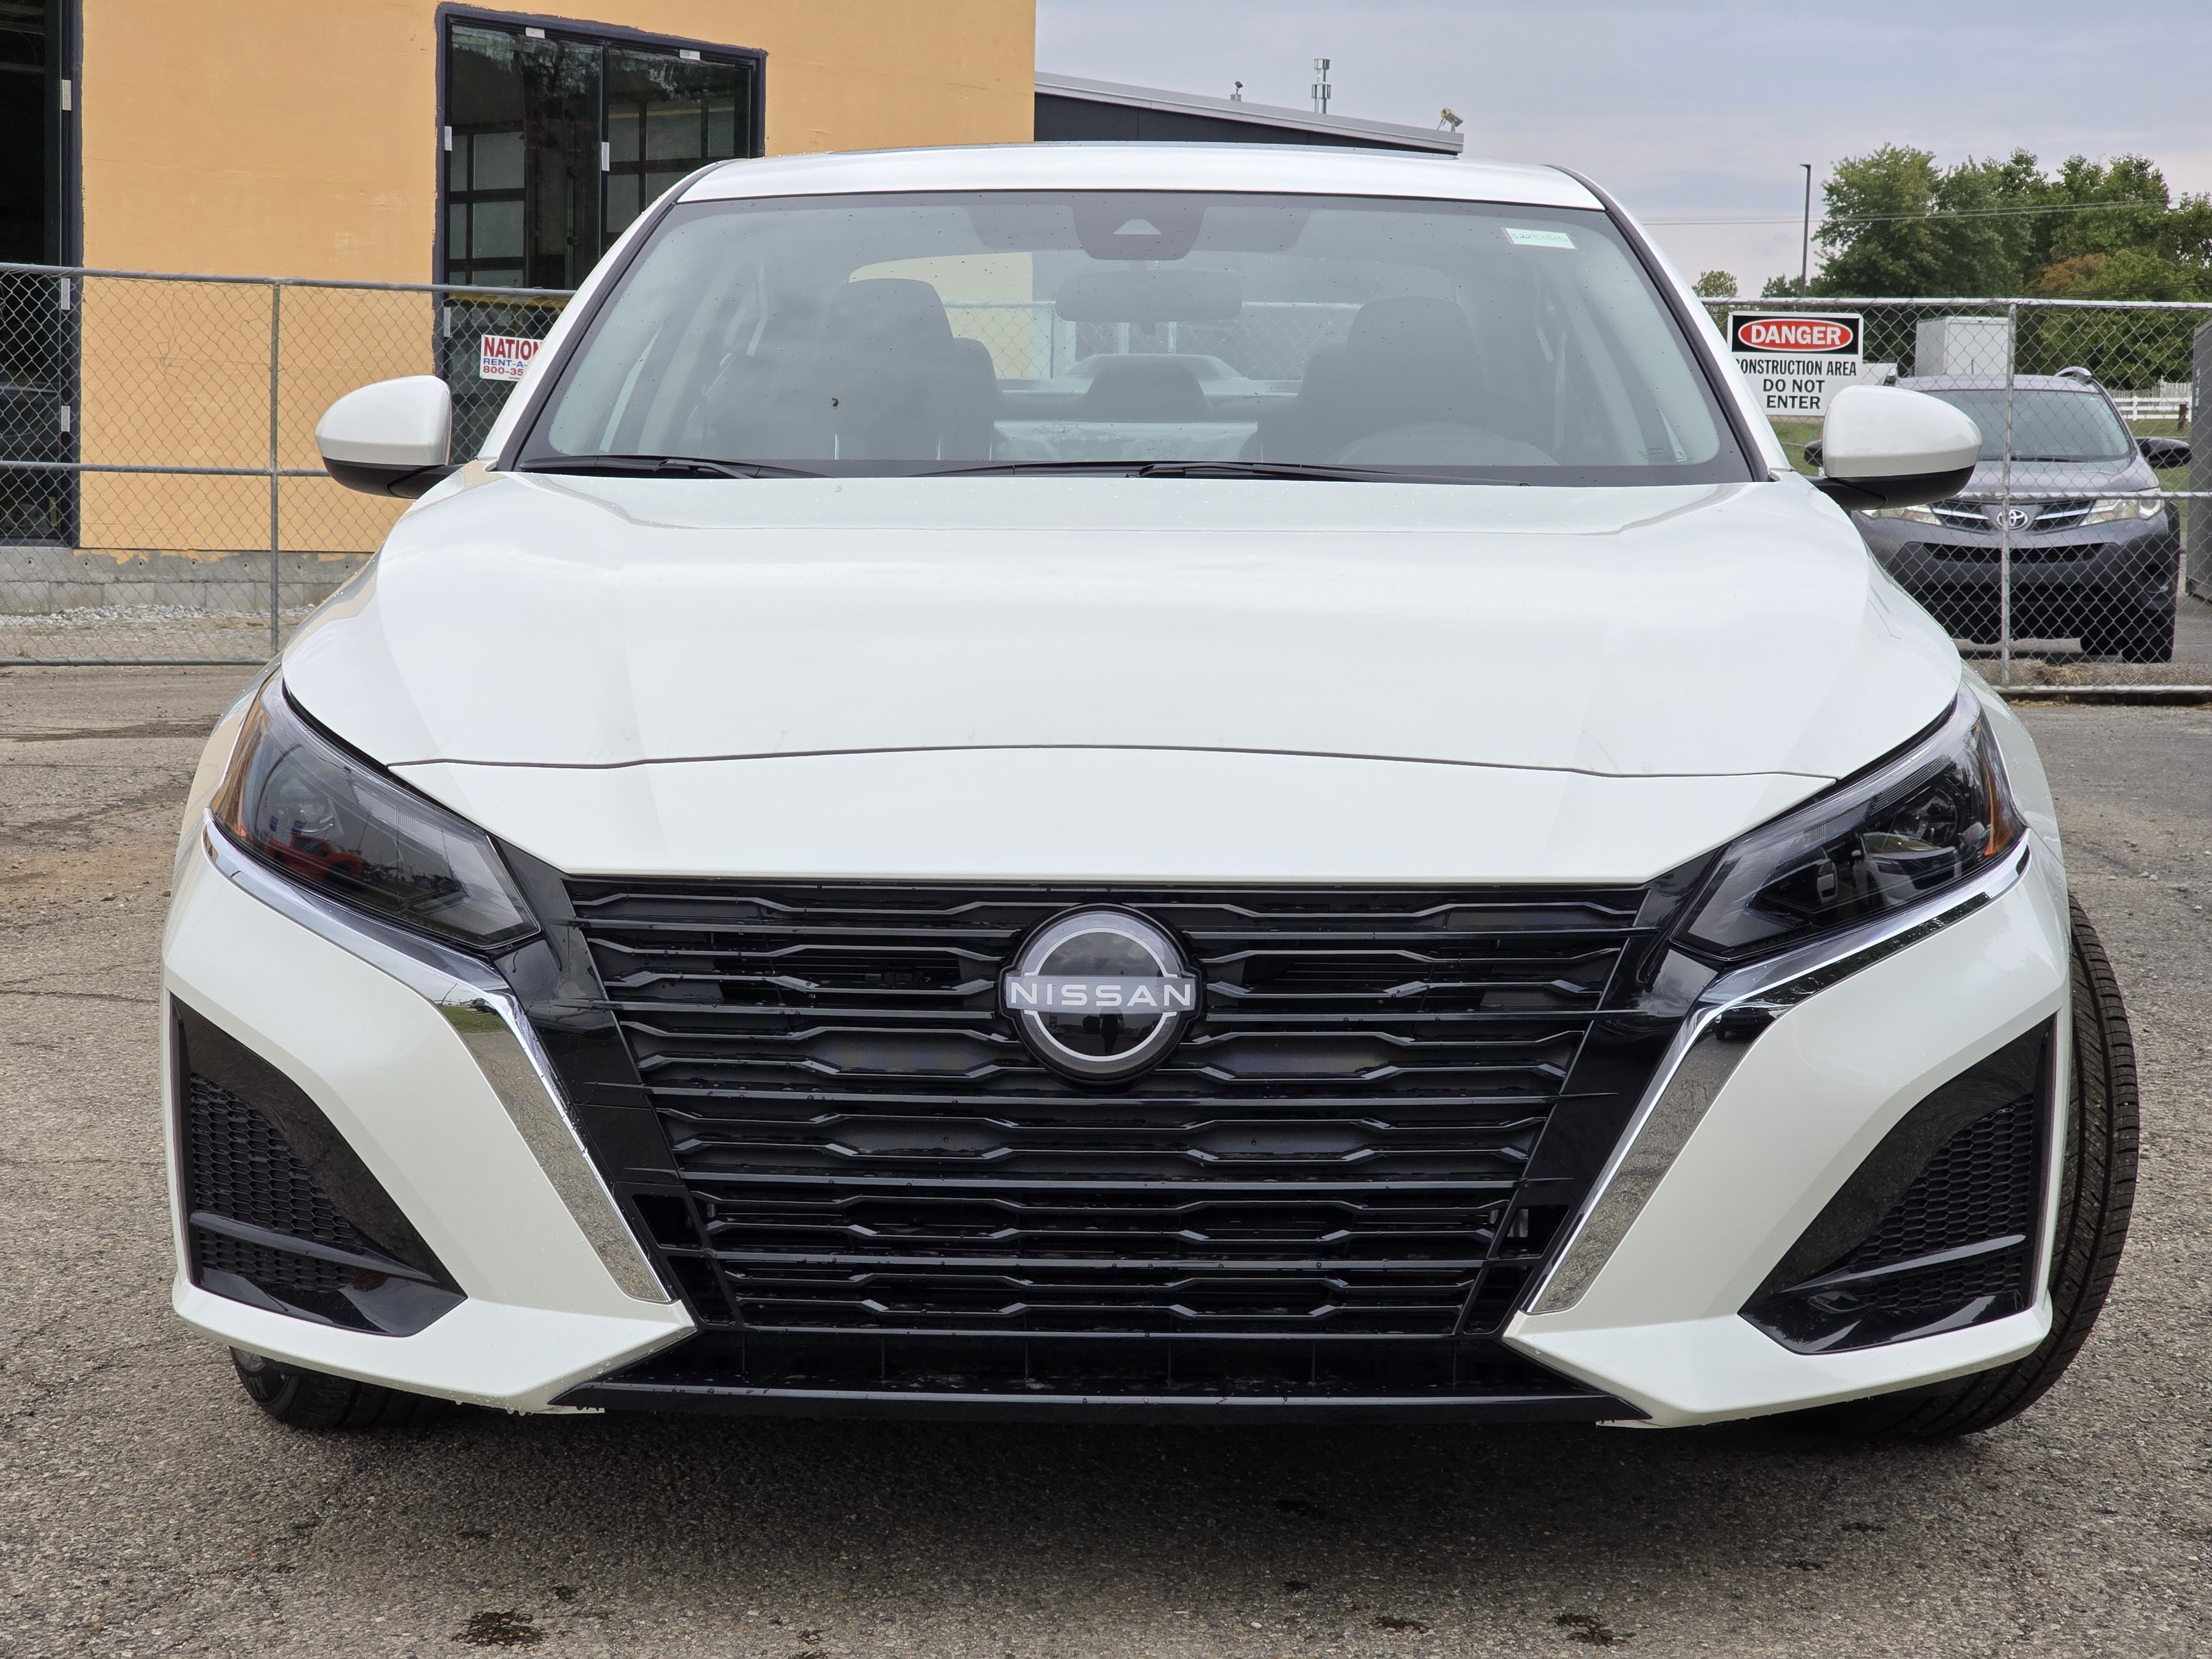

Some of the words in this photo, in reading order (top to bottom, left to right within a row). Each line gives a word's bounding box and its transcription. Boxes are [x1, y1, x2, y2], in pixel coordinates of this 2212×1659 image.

[1751, 325, 1841, 345] DANGER
[483, 366, 524, 377] 800-35
[1735, 358, 1822, 375] ONSTRUCTION
[1826, 361, 1857, 376] AREA
[1762, 379, 1786, 392] DO
[1792, 380, 1825, 393] NOT
[1766, 395, 1820, 409] ENTER
[1010, 982, 1191, 1006] NISSAN
